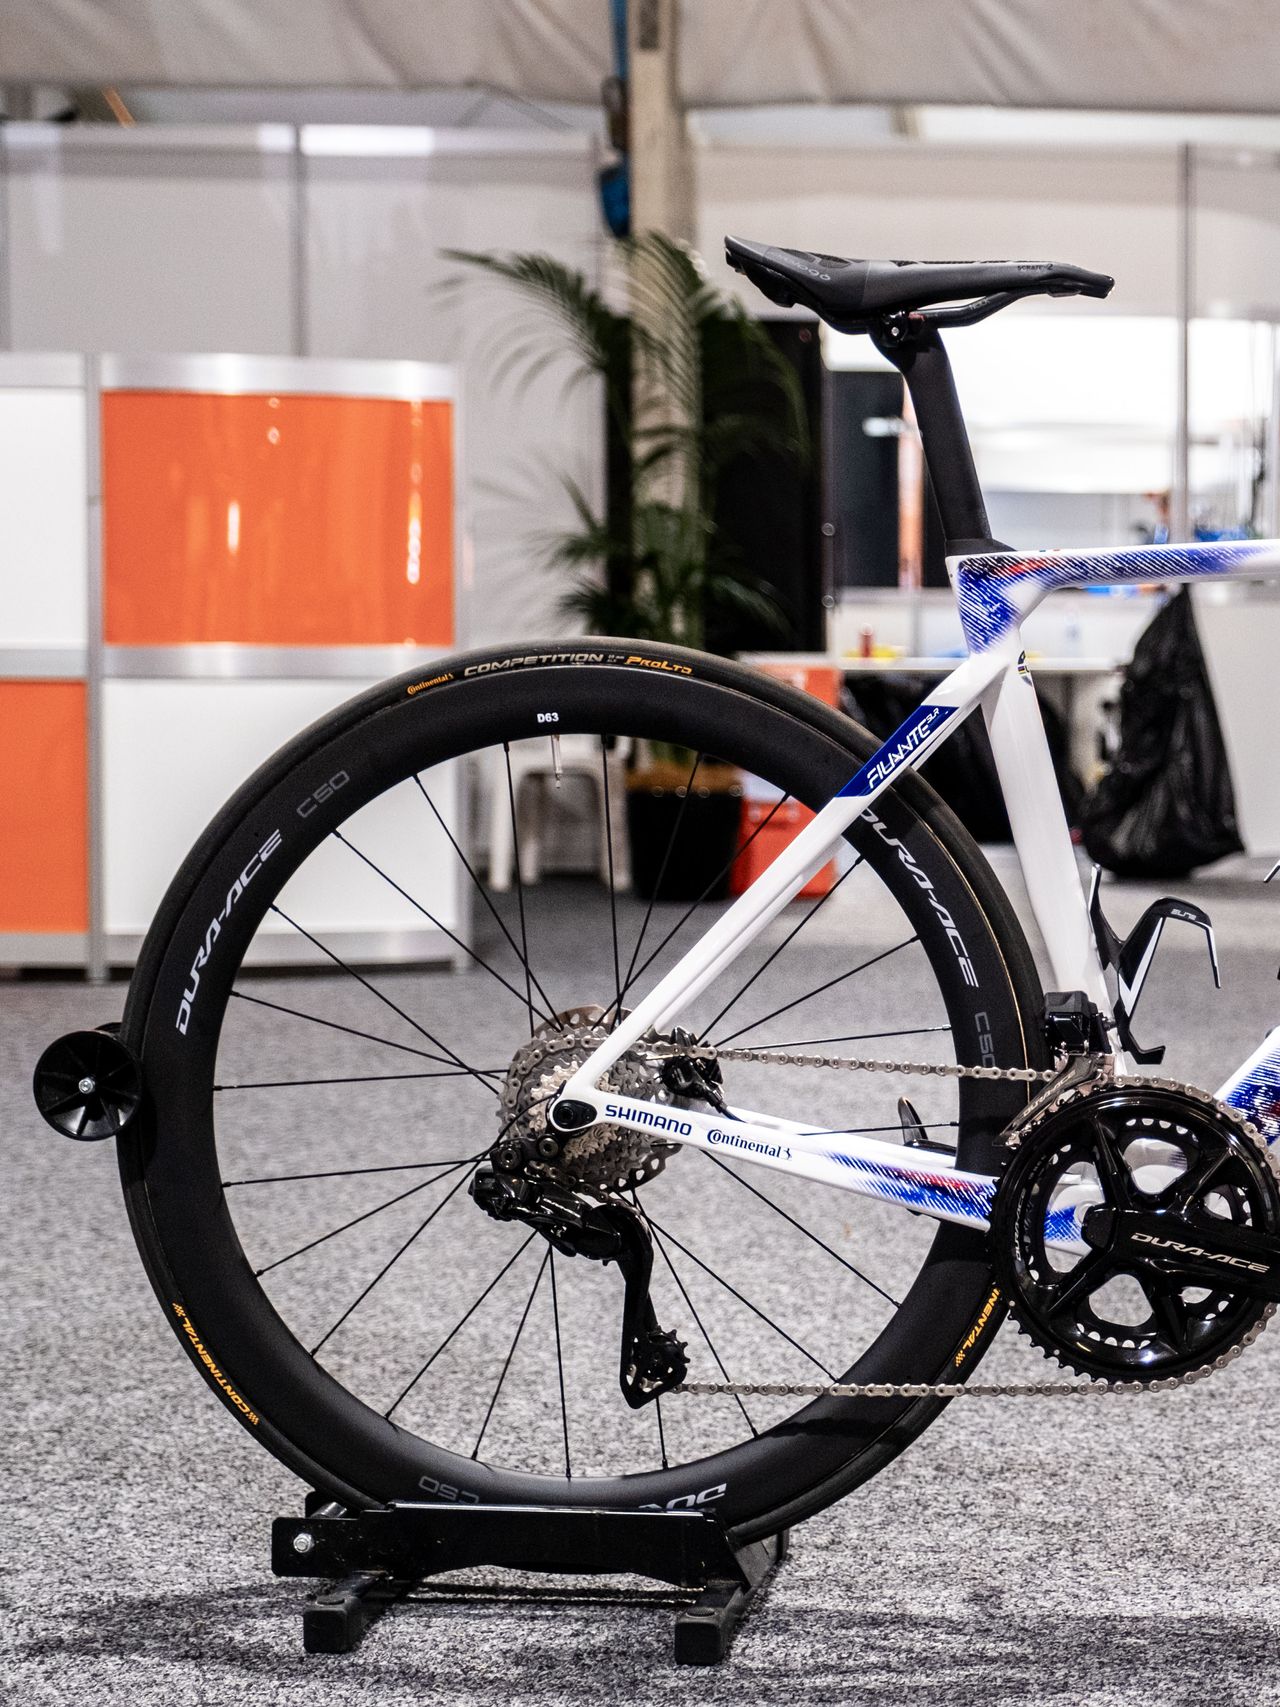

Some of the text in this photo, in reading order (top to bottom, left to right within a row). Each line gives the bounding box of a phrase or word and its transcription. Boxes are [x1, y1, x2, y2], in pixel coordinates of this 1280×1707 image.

[406, 673, 449, 695] Continental
[464, 653, 604, 677] COMPETITION
[536, 712, 560, 723] D63
[867, 719, 931, 789] FILANTE
[175, 769, 350, 1036] DURA-ACE C50
[860, 807, 980, 988] DURA-ACE
[605, 1104, 692, 1136] SHIMANO
[706, 1128, 783, 1158] Continental
[1130, 1232, 1270, 1273] DURA-ACE
[182, 1315, 251, 1415] CONTINENTAL
